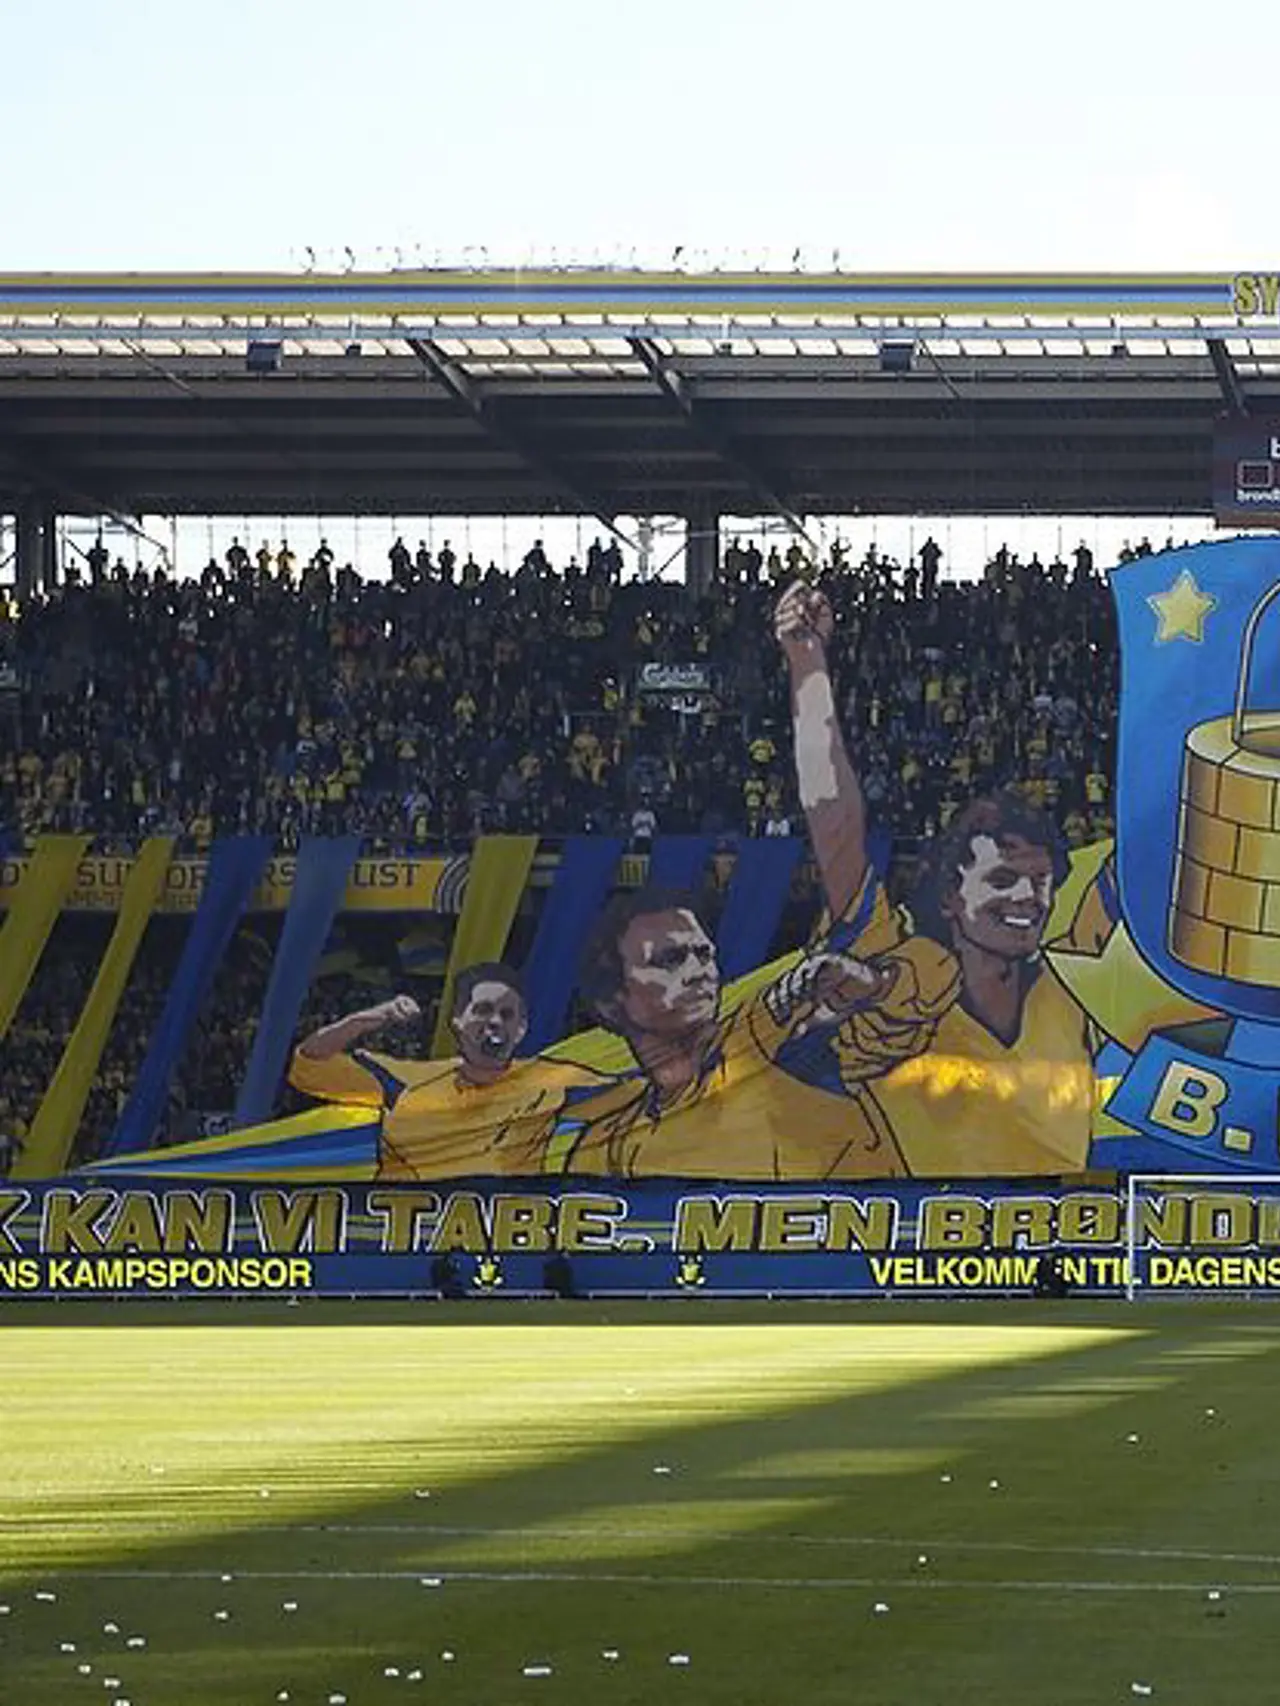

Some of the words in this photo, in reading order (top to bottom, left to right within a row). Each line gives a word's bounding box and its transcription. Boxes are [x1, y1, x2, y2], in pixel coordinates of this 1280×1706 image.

[44, 1191, 235, 1253] KAN
[256, 1191, 346, 1253] VI
[370, 1194, 650, 1253] TABE.
[678, 1197, 896, 1251] MEN
[48, 1258, 312, 1289] KAMPSPONSOR
[871, 1257, 1087, 1286] VELKOMMN
[1089, 1257, 1142, 1286] TIL
